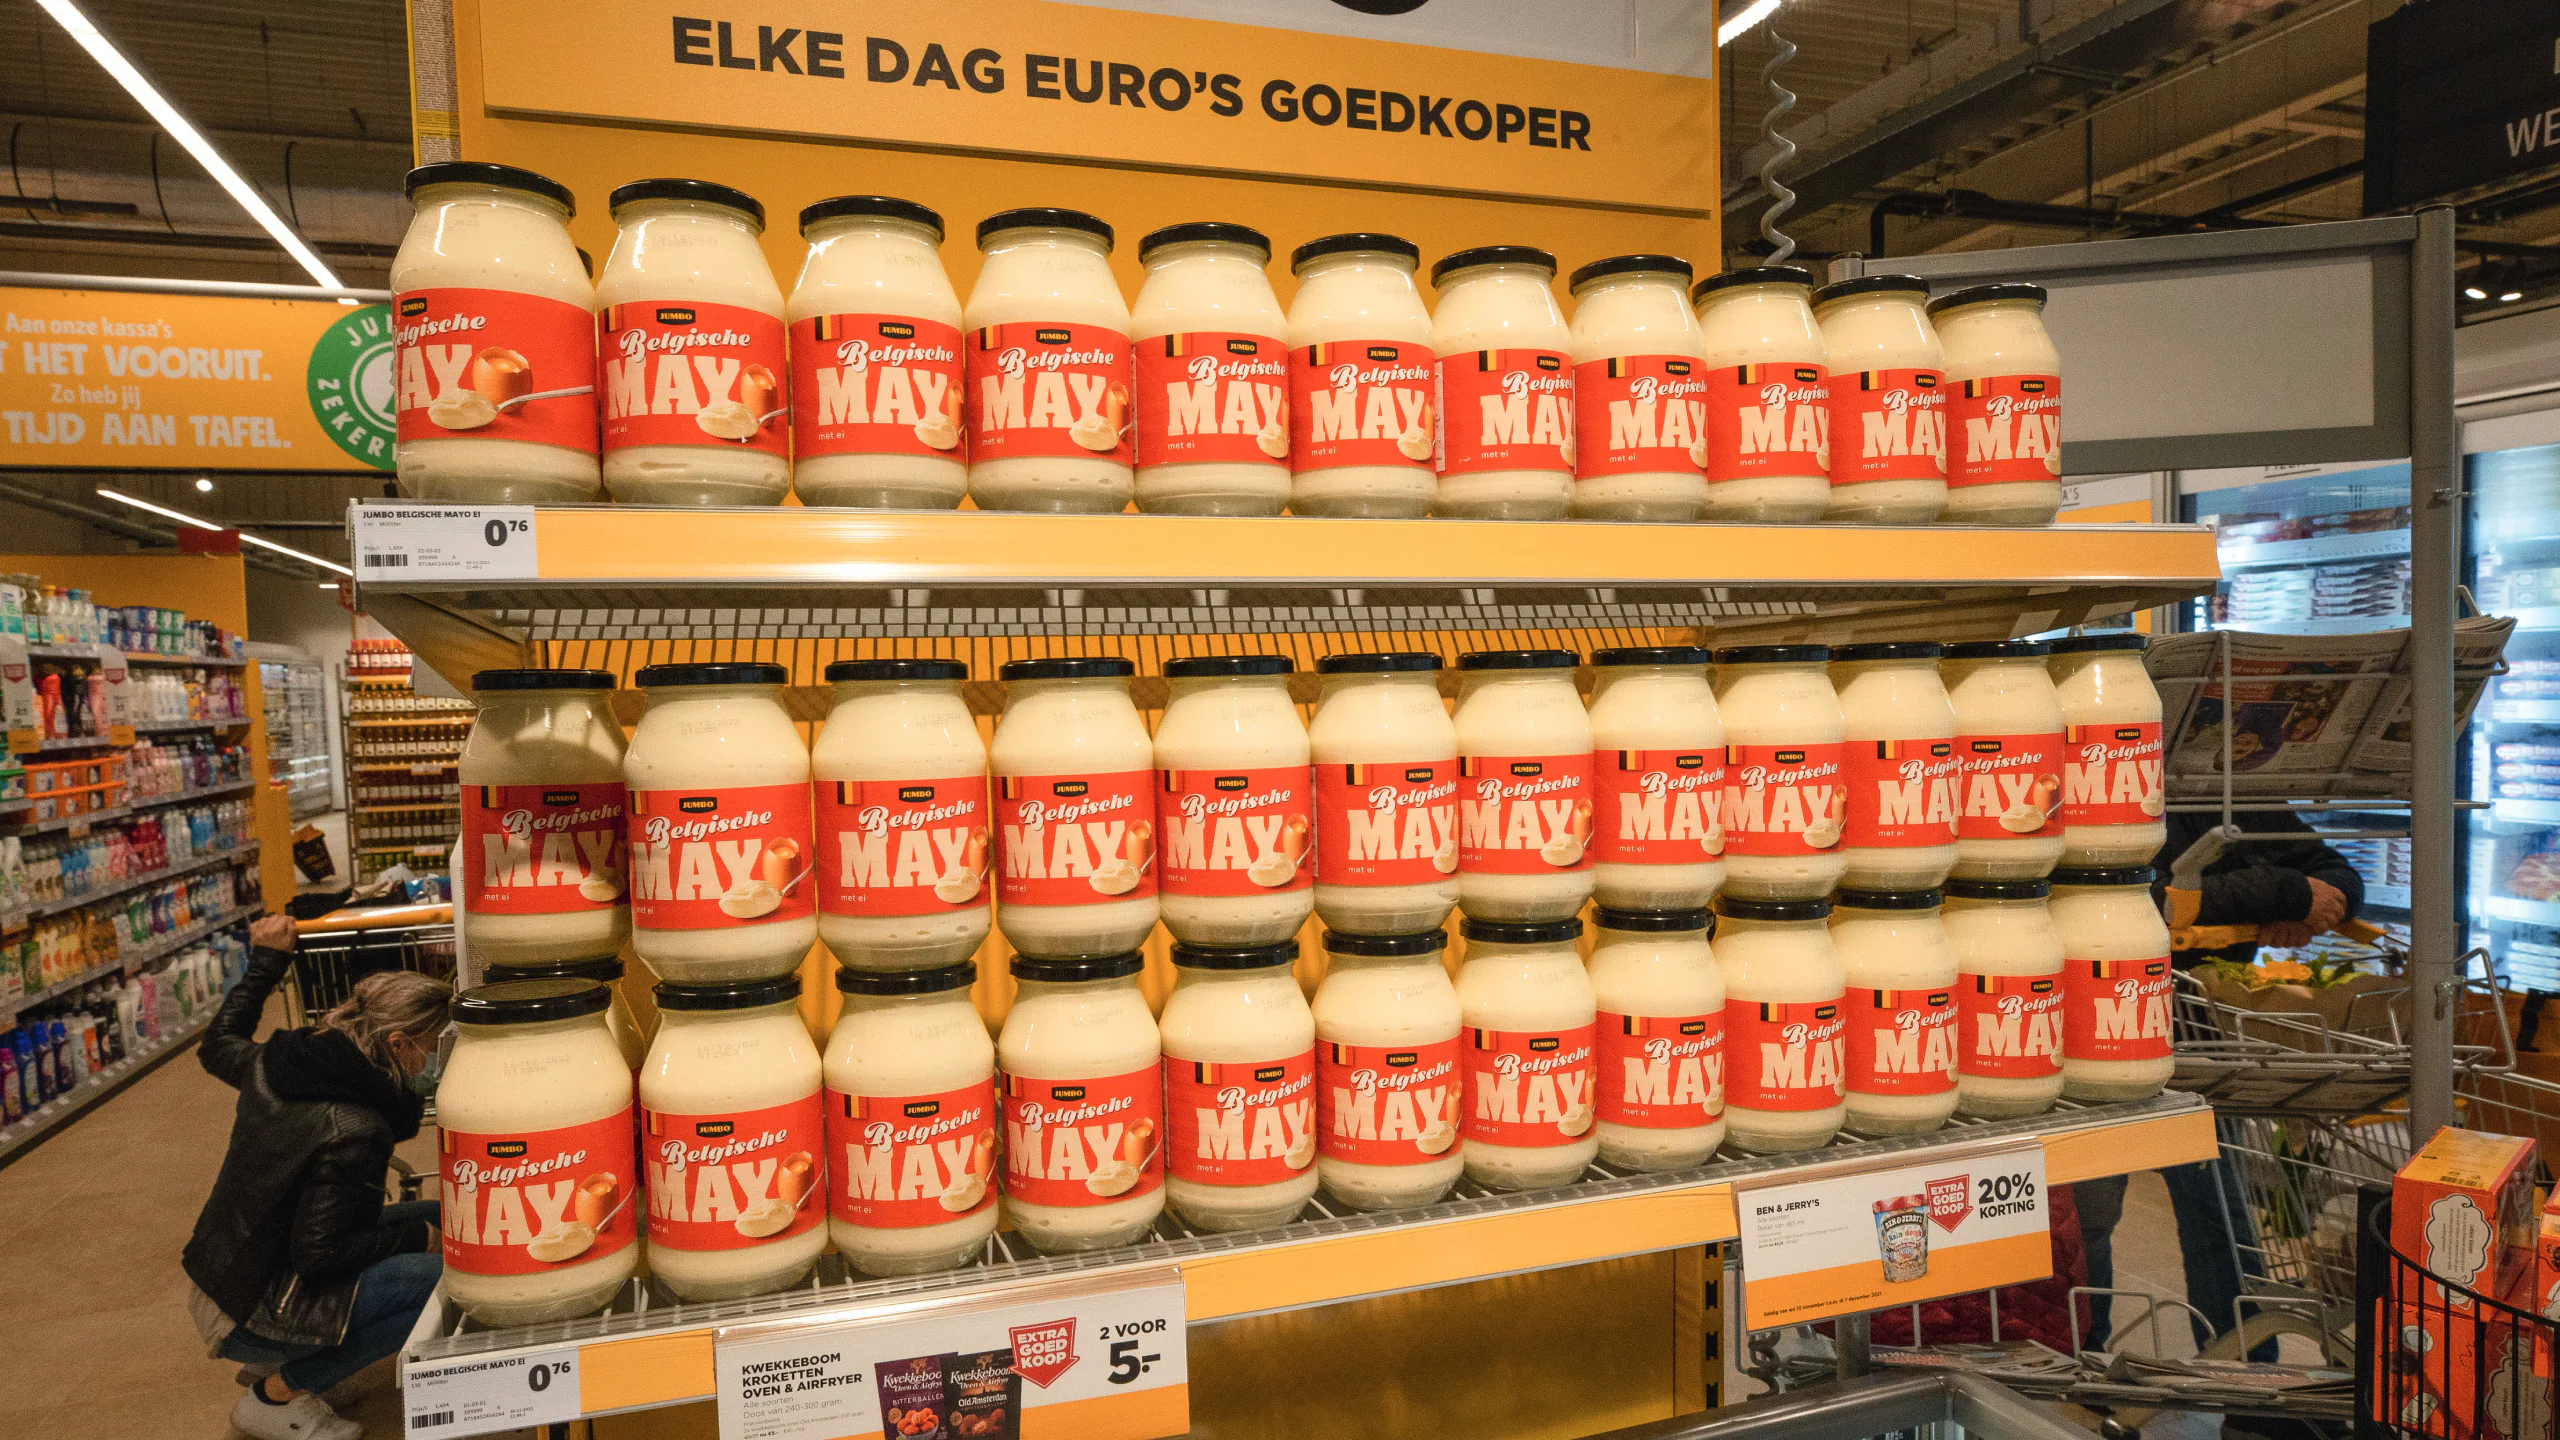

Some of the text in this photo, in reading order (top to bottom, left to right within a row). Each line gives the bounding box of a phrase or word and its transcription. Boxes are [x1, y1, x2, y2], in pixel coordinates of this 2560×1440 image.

[673, 17, 1593, 152] ELKE DAG EURO'S GOEDKOPER
[5, 313, 46, 333] Aan
[50, 319, 98, 335] onze
[659, 311, 693, 322] JUMBO
[882, 327, 912, 336] JUMBO
[620, 328, 751, 362] Belgische
[837, 339, 954, 373] Belgische
[1370, 350, 1396, 359] JUMBO
[23, 341, 88, 376] HET
[103, 344, 272, 381] VOORUIT.
[998, 347, 1114, 379] Belgische
[1188, 356, 1286, 387] Belgische
[1329, 363, 1430, 394] Belgische
[50, 383, 141, 411] Zo heb jij
[2, 410, 292, 449] TIJD AAN TAFEL.
[363, 511, 394, 519] JUMBO
[1513, 765, 1540, 773] JUMBO
[1740, 762, 1838, 792] Belgische
[1218, 779, 1246, 788] JUMBO
[1476, 774, 1580, 806] Belgische
[683, 800, 714, 809] JUMBO
[1018, 794, 1133, 831] Belgische
[1181, 788, 1291, 823] Belgische
[502, 804, 622, 840] Belgische
[645, 809, 772, 849] Belgische
[858, 800, 975, 838] Belgische
[1389, 1055, 1416, 1064] JUMBO
[1493, 1044, 1590, 1081] Belgische
[1350, 1060, 1453, 1097] Belgische
[1216, 1071, 1313, 1116] Belgische
[1020, 1094, 1132, 1132] Belgische
[699, 1124, 731, 1135] JUMBO
[864, 1106, 981, 1152] Belgische
[660, 1129, 788, 1172] Belgische
[453, 1148, 587, 1193] Belgische
[1931, 1182, 1965, 1196] EXTRA
[1932, 1191, 1965, 1205] GOED
[1977, 1172, 2035, 1204] 20%
[1756, 1205, 1774, 1215] BEN
[1776, 1204, 1783, 1212] &
[1933, 1202, 1965, 1217] KOOP
[1979, 1199, 2035, 1219] KORTING
[1802, 1301, 1825, 1310] november
[1848, 1293, 1871, 1302] december
[1016, 1327, 1068, 1344] EXTRA
[1100, 1318, 1166, 1340] 2 VOOR
[1019, 1339, 1067, 1356] GOED
[411, 1357, 525, 1381] JUMBO BELGISCHE MAYO EI
[742, 1352, 841, 1375] KWEKKEBOOM
[1021, 1351, 1067, 1369] KOOP
[742, 1366, 824, 1388] KROKETTEN
[742, 1373, 863, 1400] OVEN & AIRFRYER
[883, 1370, 942, 1388] Kwekkeboo
[743, 1396, 794, 1409] Alle soorten
[743, 1399, 843, 1419] Doos van 240-300 gram
